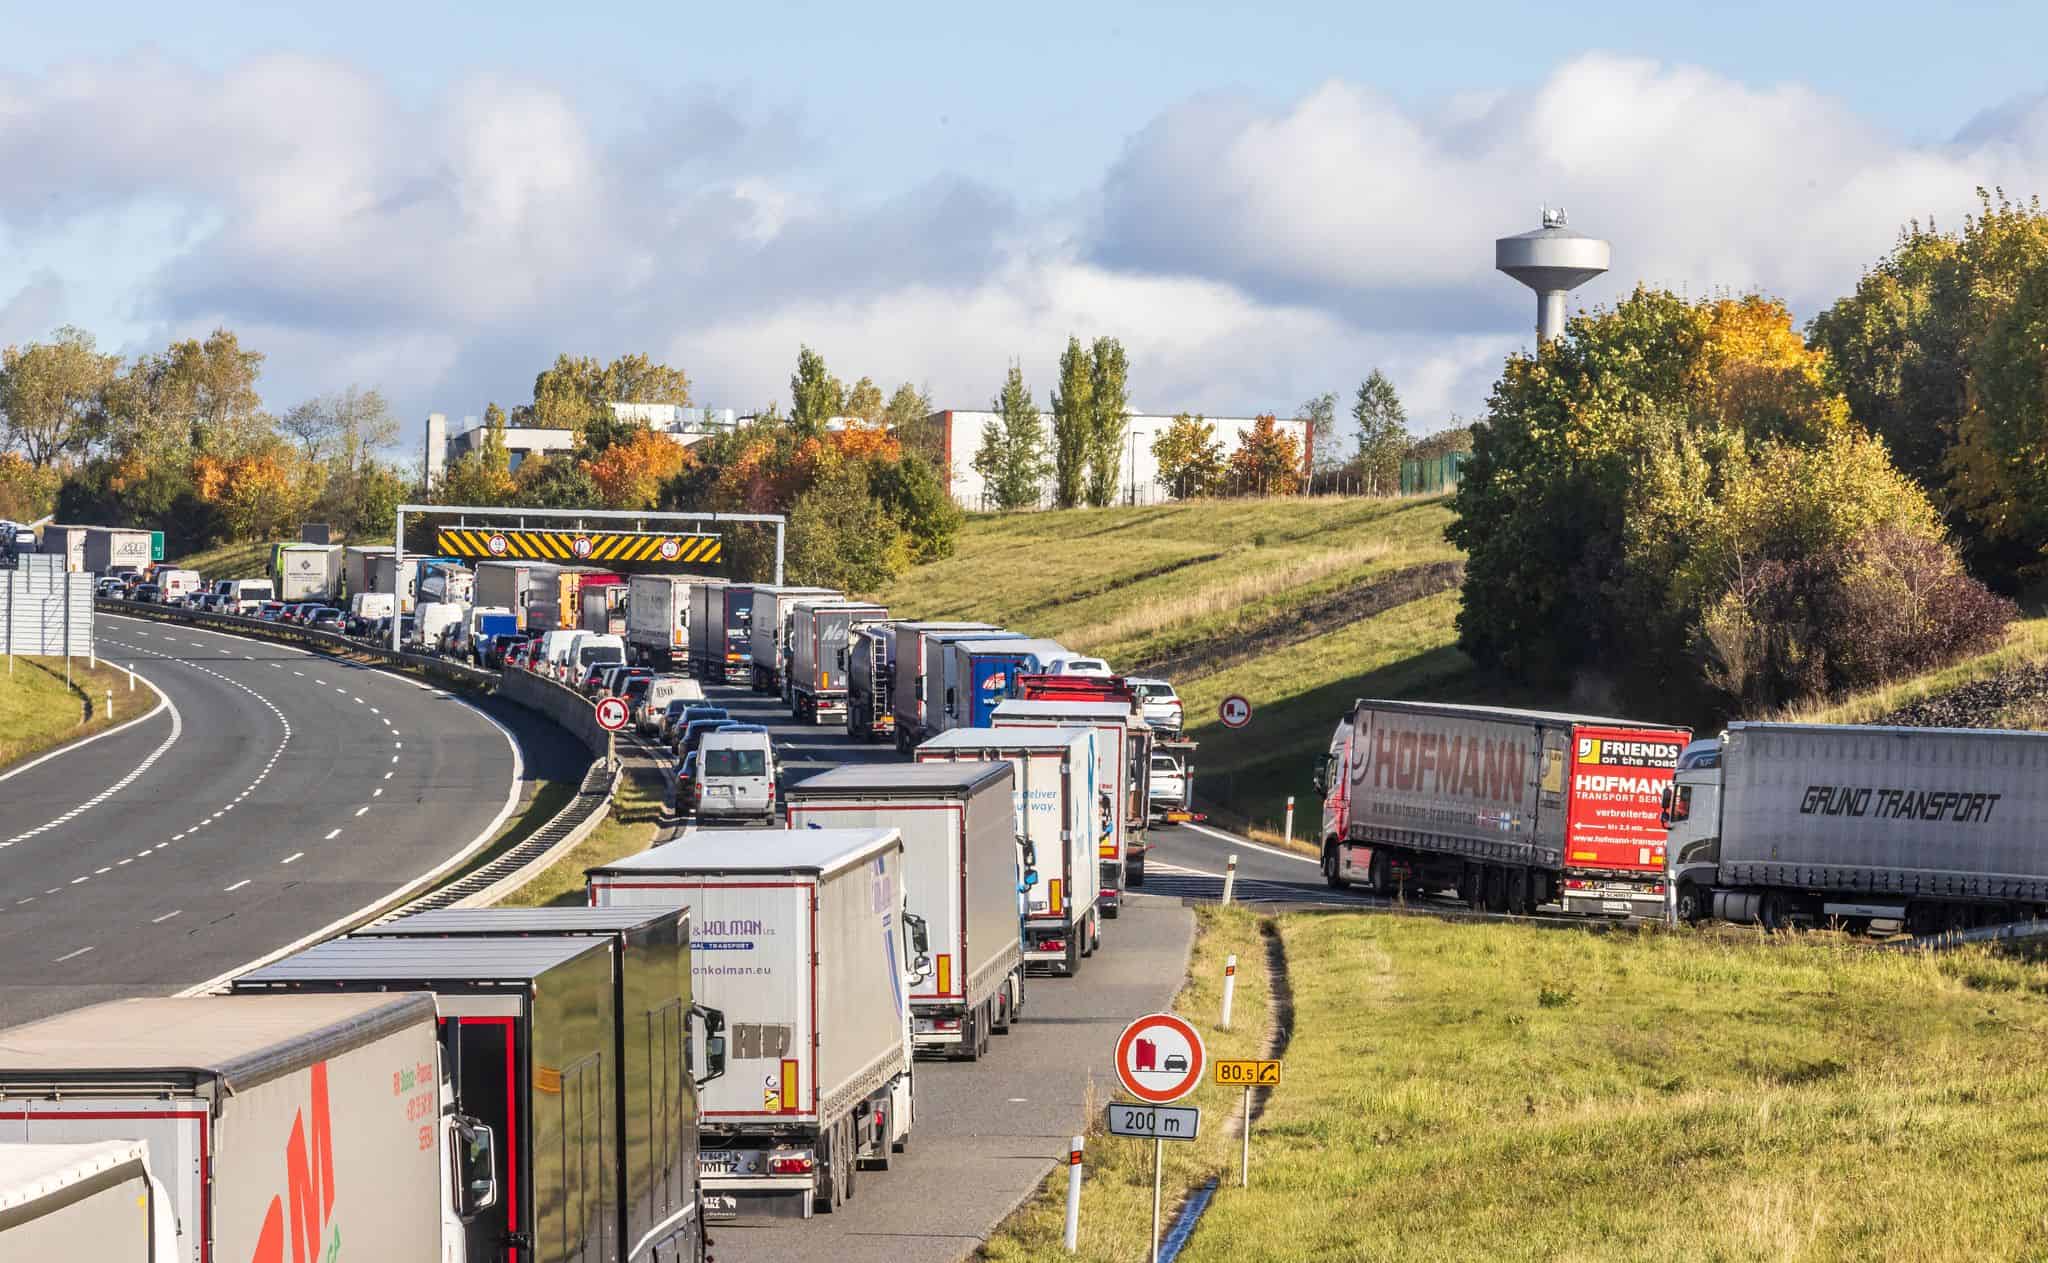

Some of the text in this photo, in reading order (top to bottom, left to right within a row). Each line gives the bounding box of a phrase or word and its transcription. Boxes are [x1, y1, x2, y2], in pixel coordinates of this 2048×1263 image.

[1601, 741, 1678, 758] FRIENDS
[1374, 728, 1526, 803] HOFMANN
[1601, 756, 1677, 768] on the road
[1575, 791, 1635, 803] TRANSPORT
[1875, 788, 2001, 823] TRANSPORT
[704, 920, 762, 936] KOLMAN
[692, 965, 771, 976] onkolman.eu
[1125, 1111, 1180, 1132] 200 m
